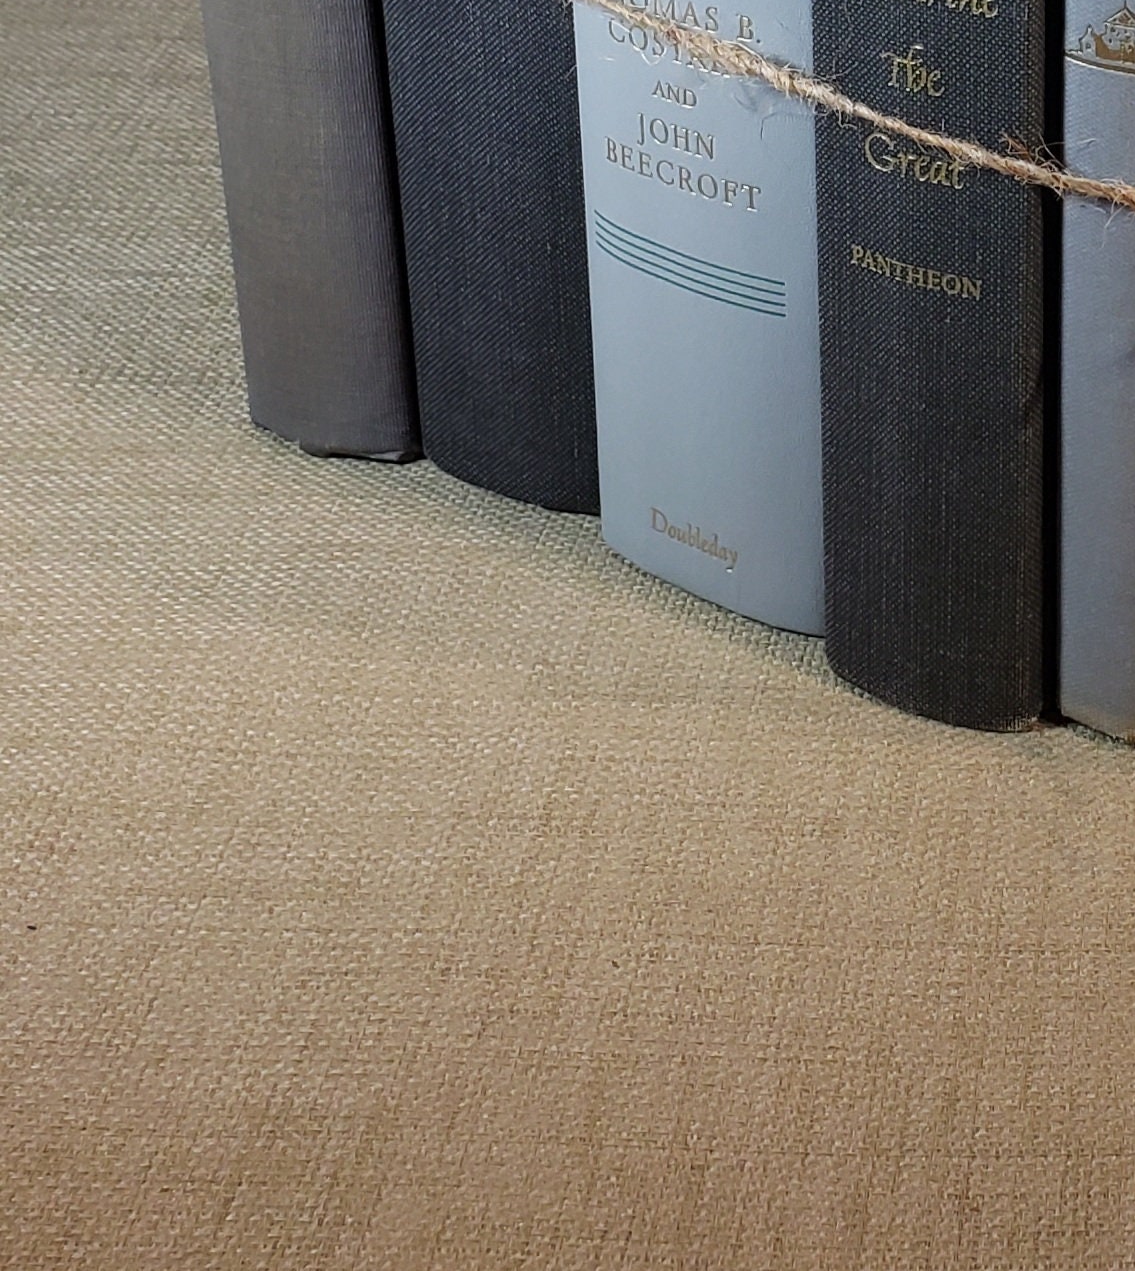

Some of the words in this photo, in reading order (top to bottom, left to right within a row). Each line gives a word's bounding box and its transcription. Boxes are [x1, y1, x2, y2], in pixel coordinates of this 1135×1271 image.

[736, 12, 762, 45] B.
[652, 80, 697, 109] AND
[637, 112, 716, 161] JOHN
[864, 132, 966, 191] Great
[605, 136, 762, 214] BEECROFT
[850, 244, 984, 301] PANTHEON
[650, 507, 739, 573] Doubleday
